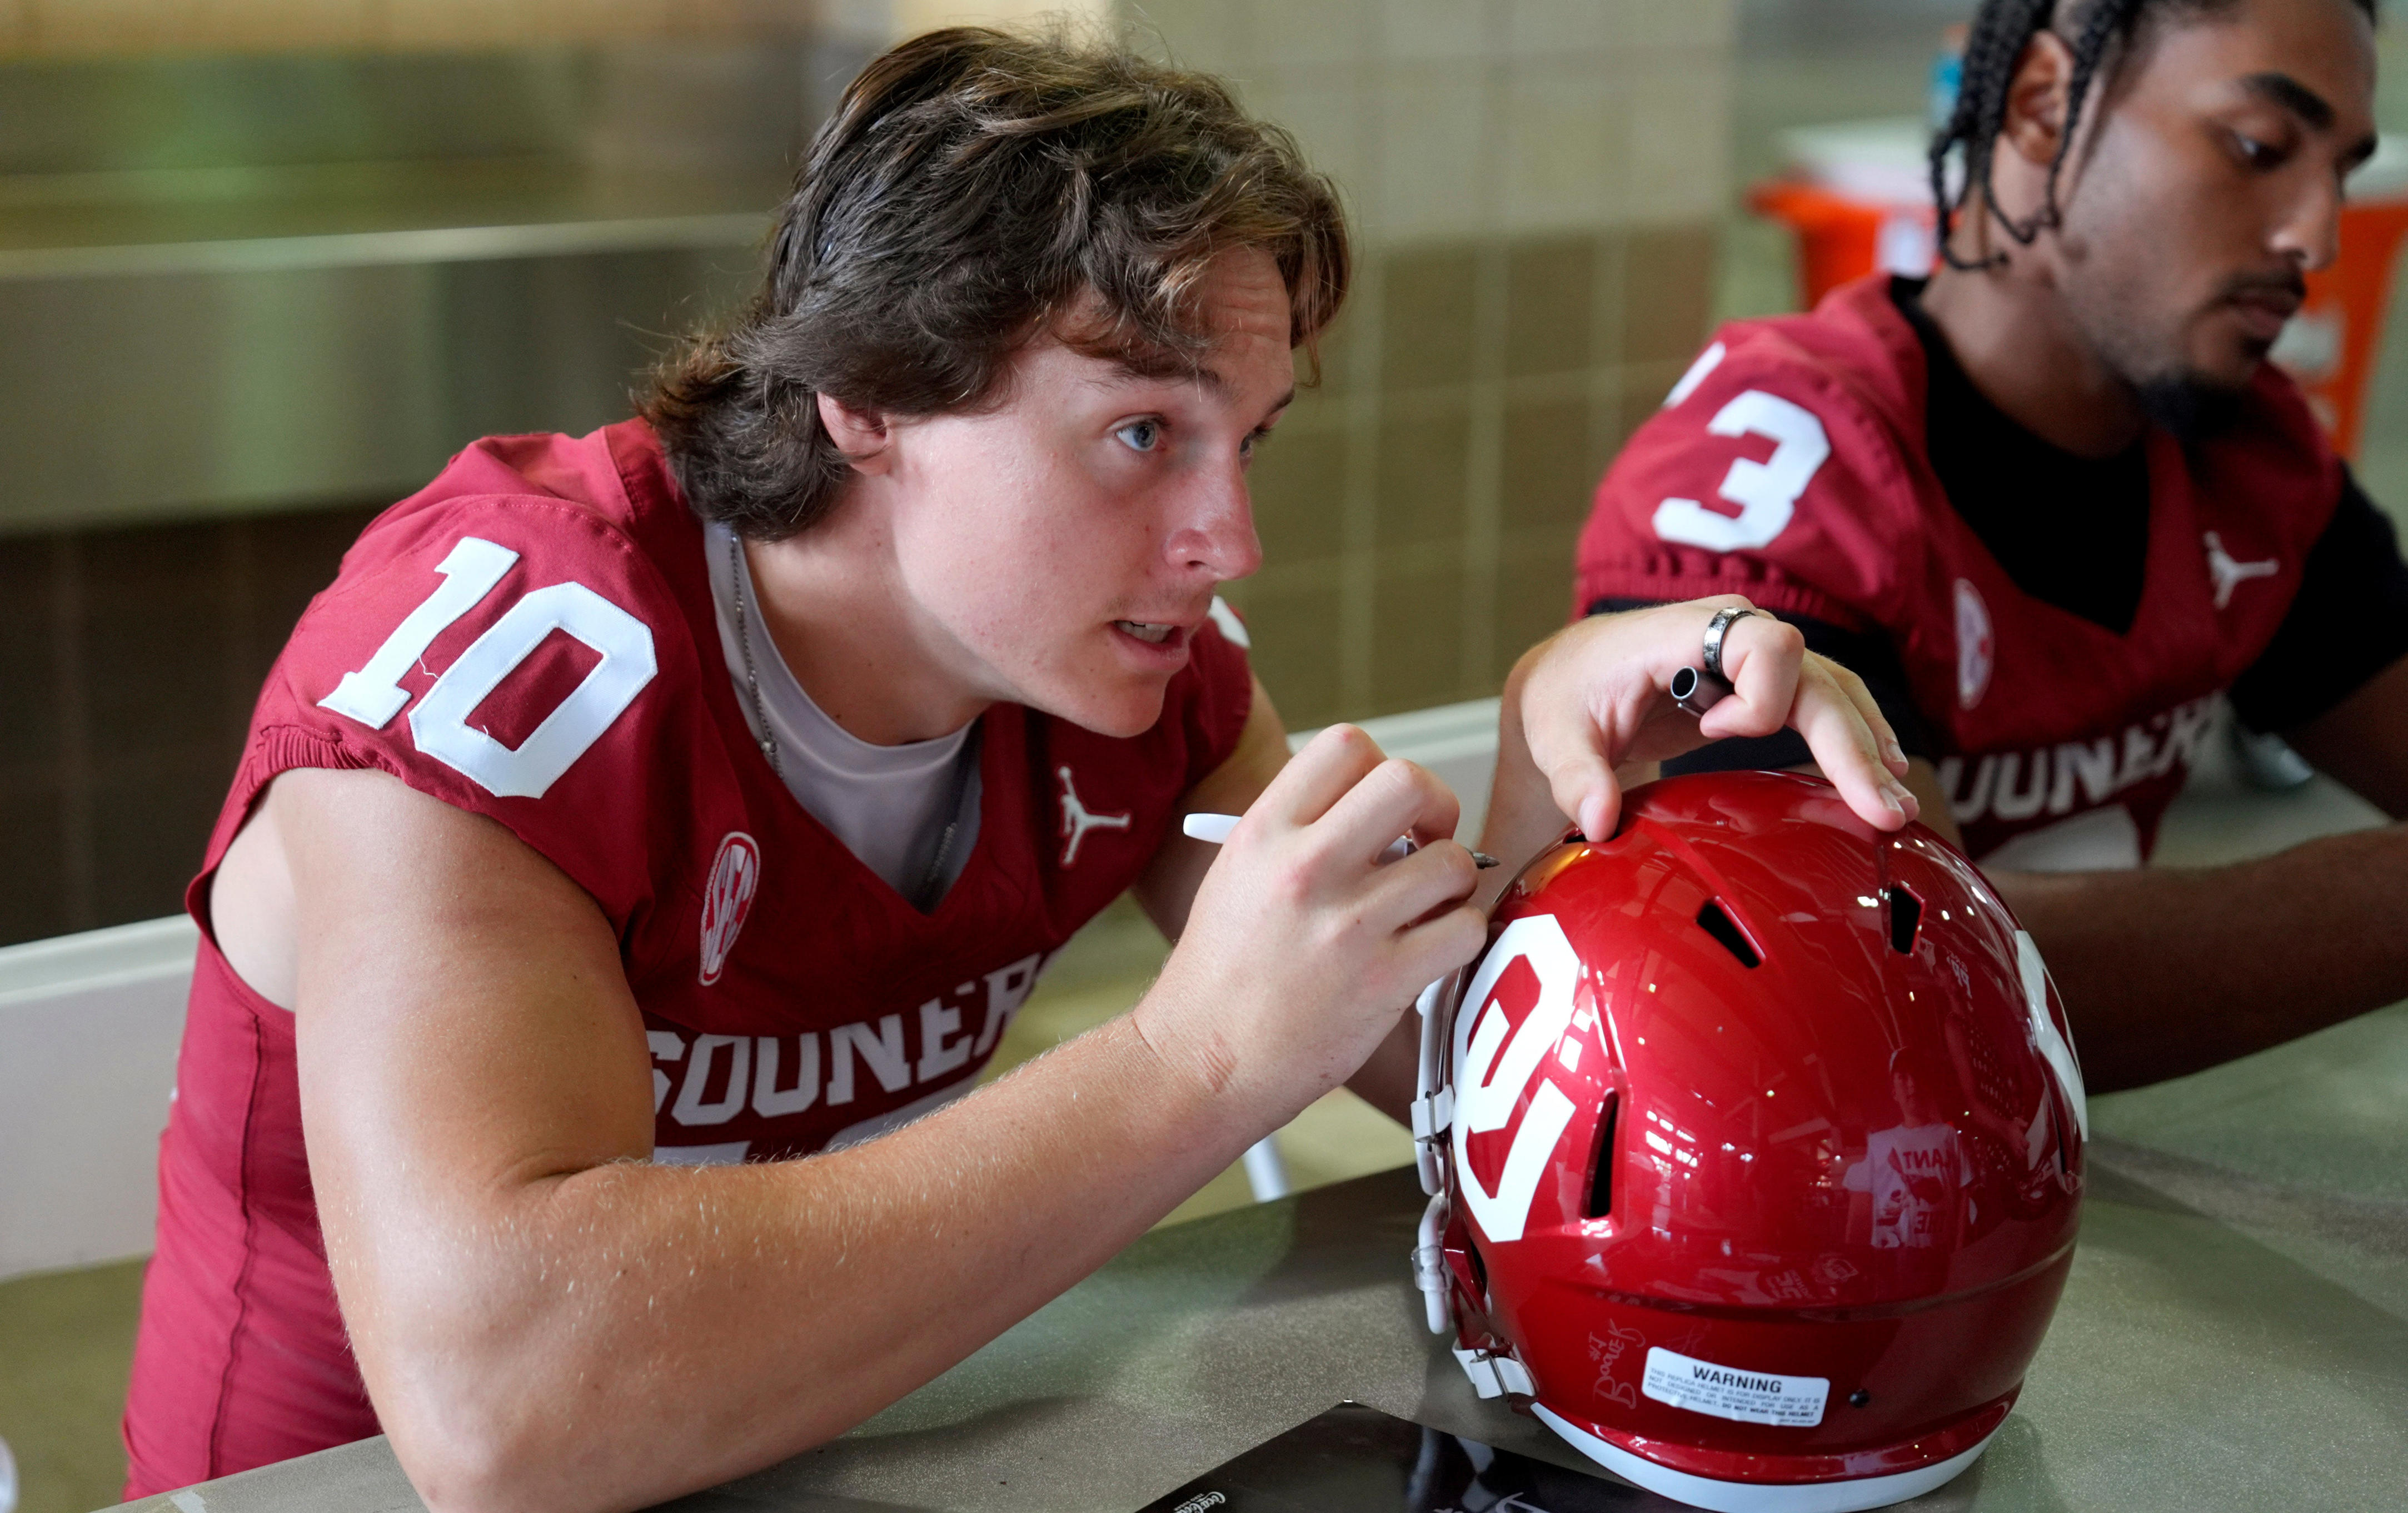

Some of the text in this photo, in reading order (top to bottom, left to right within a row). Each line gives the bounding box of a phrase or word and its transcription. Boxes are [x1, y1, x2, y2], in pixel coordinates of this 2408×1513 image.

[1652, 341, 1831, 553] 3
[316, 536, 659, 799] 10
[1668, 1372, 1695, 1386] REPLICA
[1697, 1382, 1725, 1392] HELMET
[1668, 1381, 1702, 1395] DESIGNED
[1722, 1395, 1756, 1405] INTENDED
[1693, 1365, 1783, 1394] WARNING
